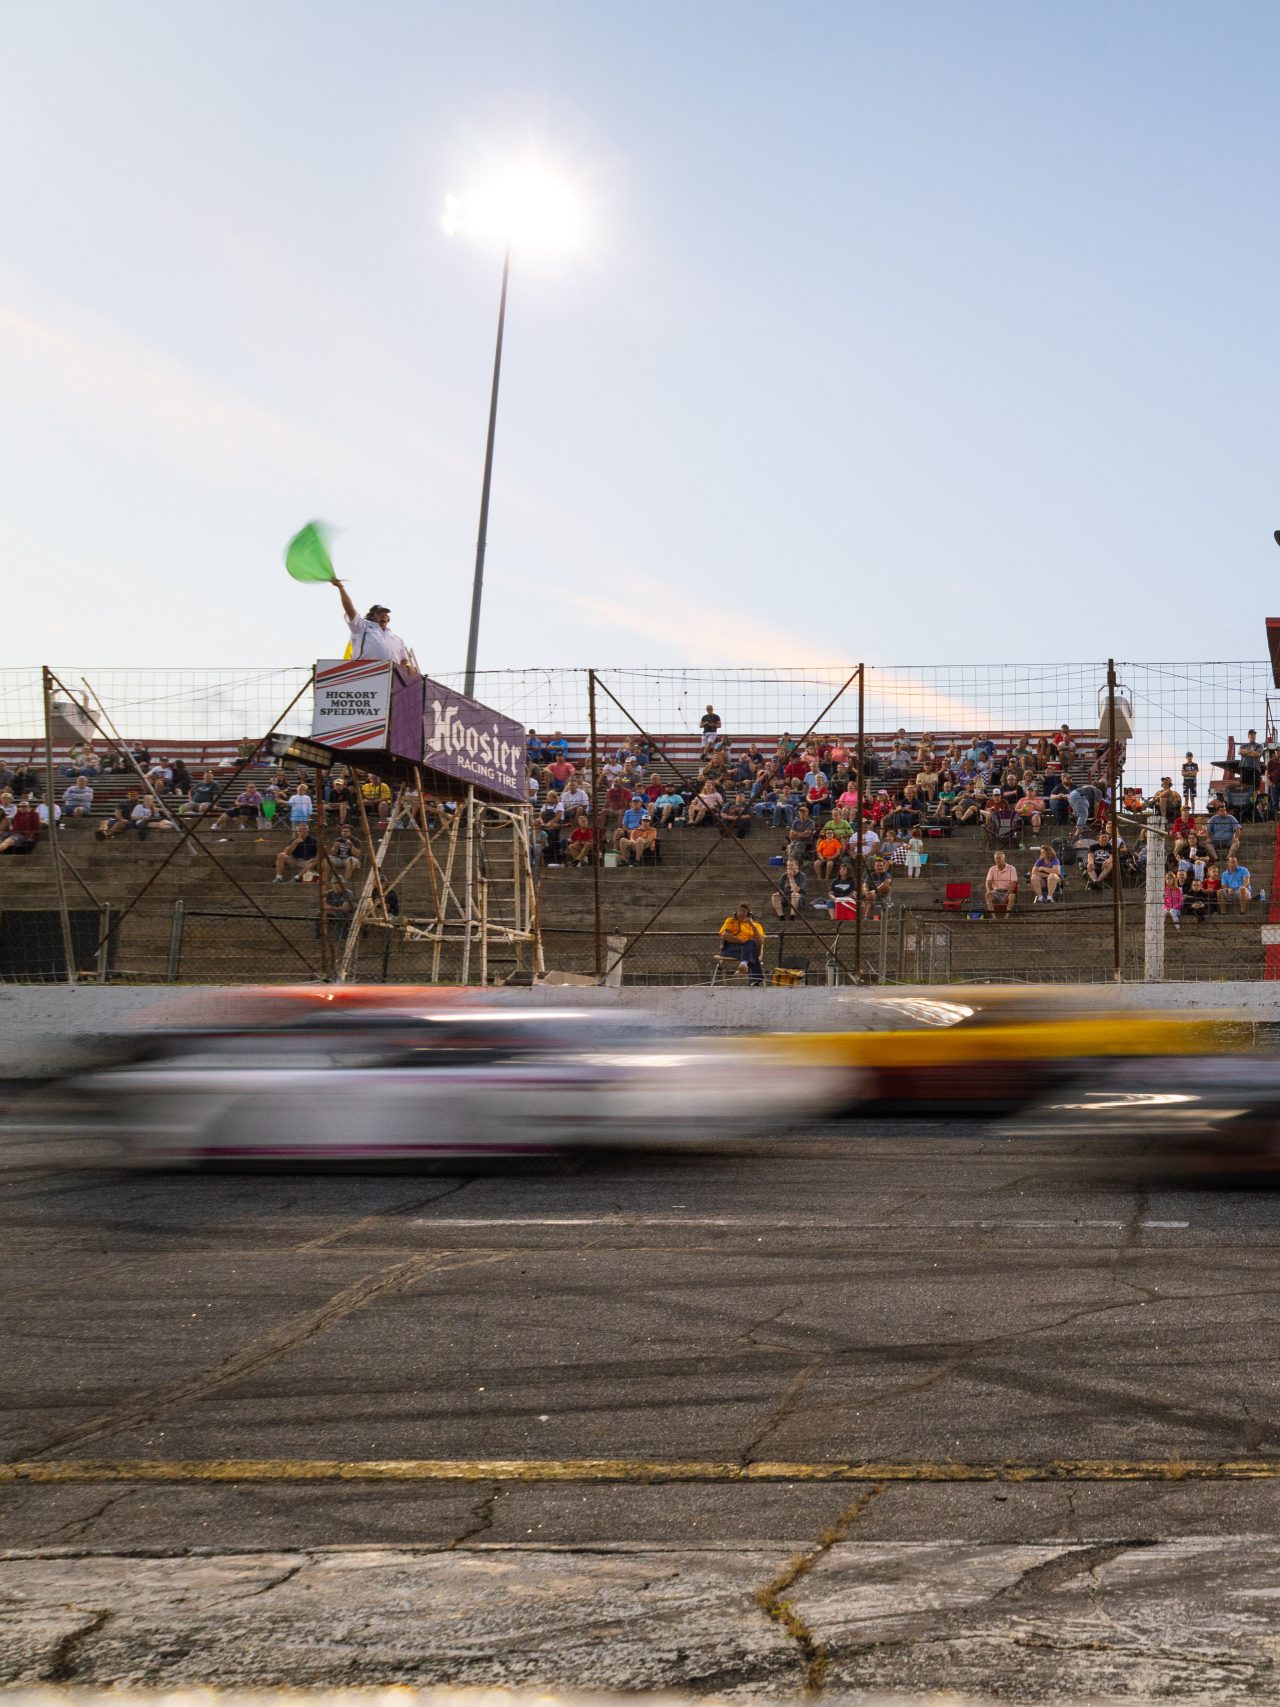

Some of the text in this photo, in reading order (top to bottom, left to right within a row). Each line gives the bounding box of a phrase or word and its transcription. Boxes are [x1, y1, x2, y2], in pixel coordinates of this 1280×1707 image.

[325, 691, 378, 699] HICKORY
[330, 699, 371, 707] MOTOR
[320, 708, 381, 716] SPEEDWAY
[428, 700, 522, 776] Hoosier
[457, 755, 518, 789] RACING TIRE
